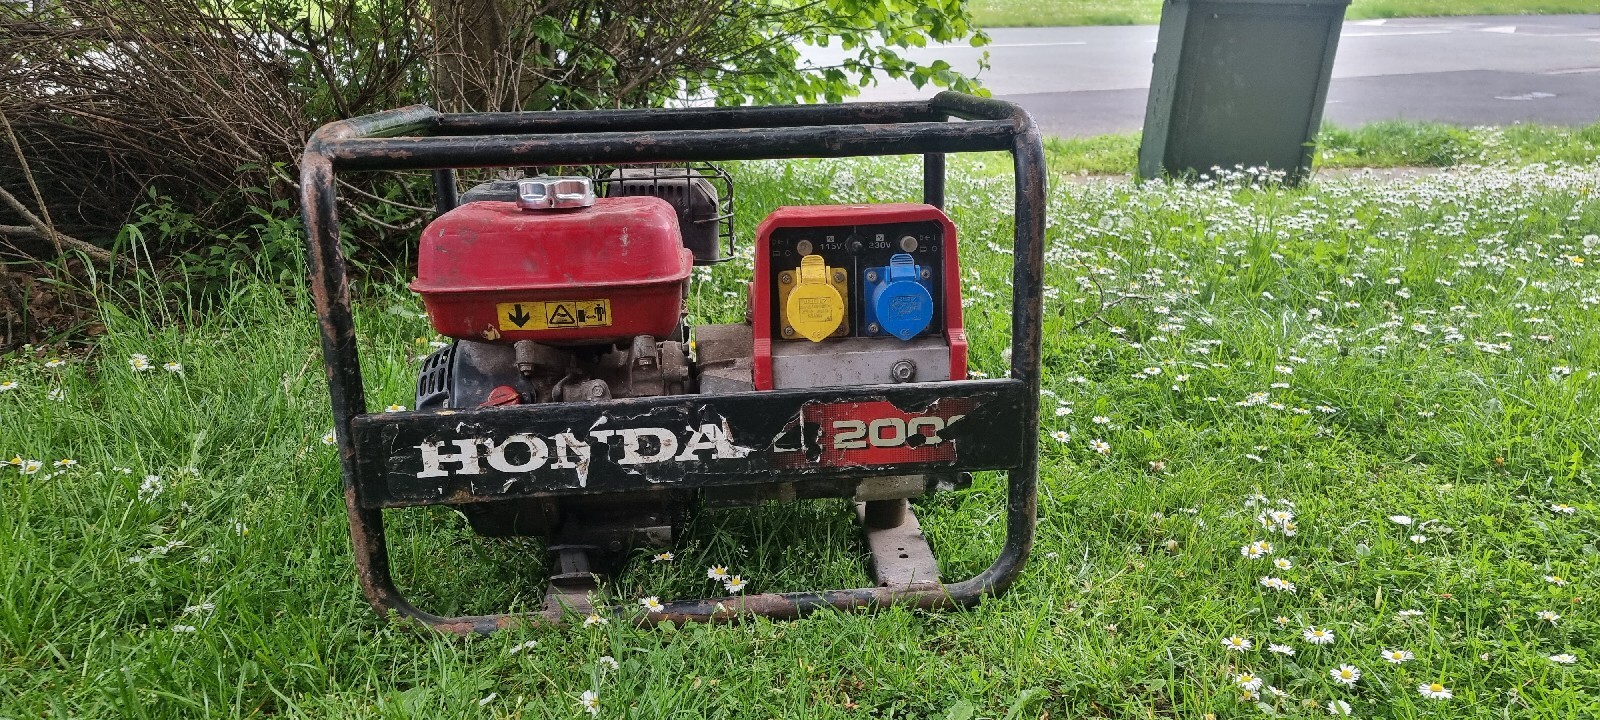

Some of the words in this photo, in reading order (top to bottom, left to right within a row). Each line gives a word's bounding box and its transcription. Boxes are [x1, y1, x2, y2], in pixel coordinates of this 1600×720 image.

[868, 241, 892, 249] 230V
[833, 415, 965, 449] 200
[414, 423, 751, 479] HONDA
